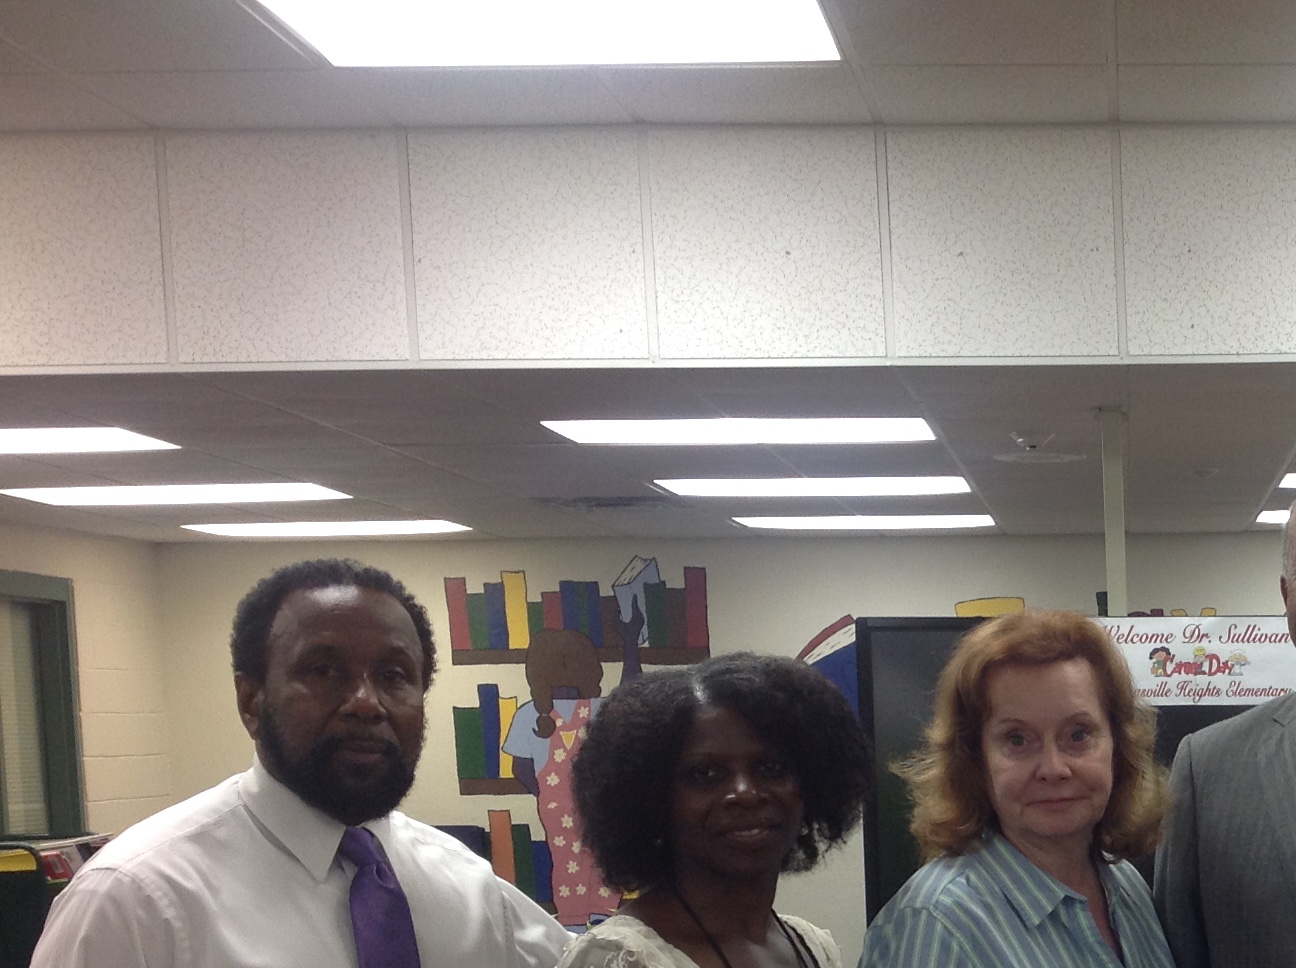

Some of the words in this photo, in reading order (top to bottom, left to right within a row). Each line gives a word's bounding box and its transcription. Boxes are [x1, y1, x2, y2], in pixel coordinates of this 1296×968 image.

[1104, 624, 1176, 644] Welcome
[1182, 623, 1212, 644] Dr.
[1219, 623, 1291, 644] Sullivan
[1175, 680, 1222, 703] Heights
